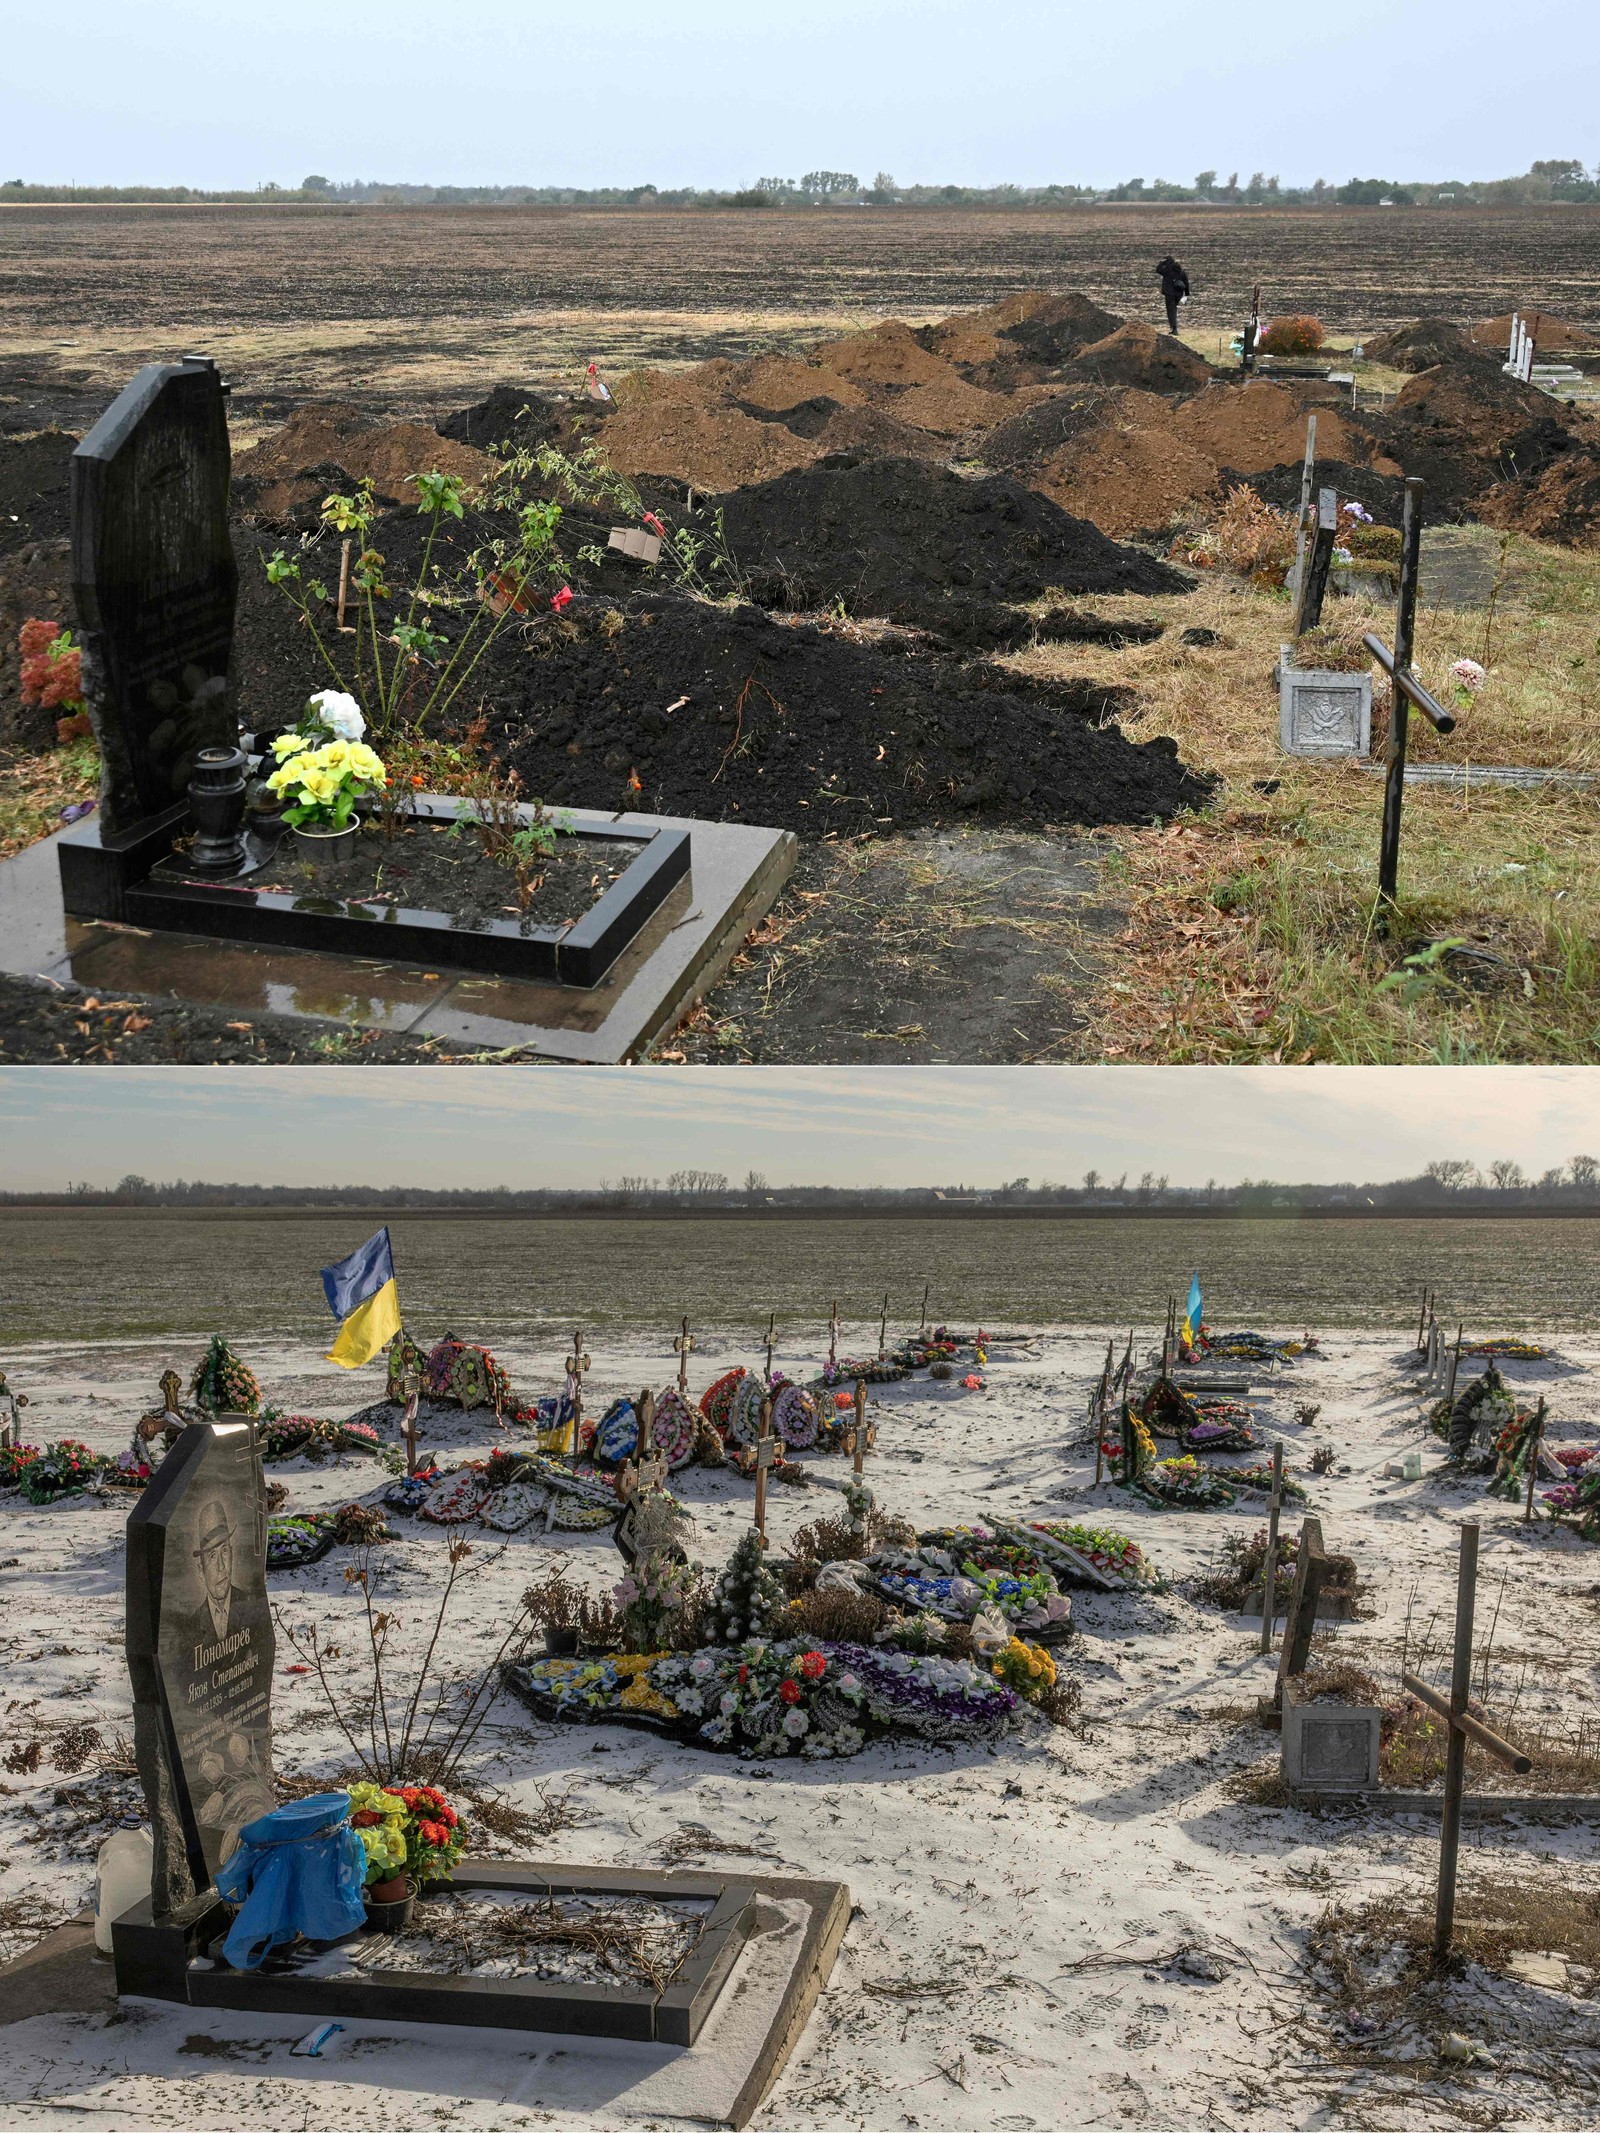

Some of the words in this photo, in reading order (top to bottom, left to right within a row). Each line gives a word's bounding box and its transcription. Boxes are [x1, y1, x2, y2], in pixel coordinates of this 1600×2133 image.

[194, 1627, 250, 1671] Пономарёв
[188, 1682, 208, 1704] Яков
[212, 1654, 259, 1689] Степанович
